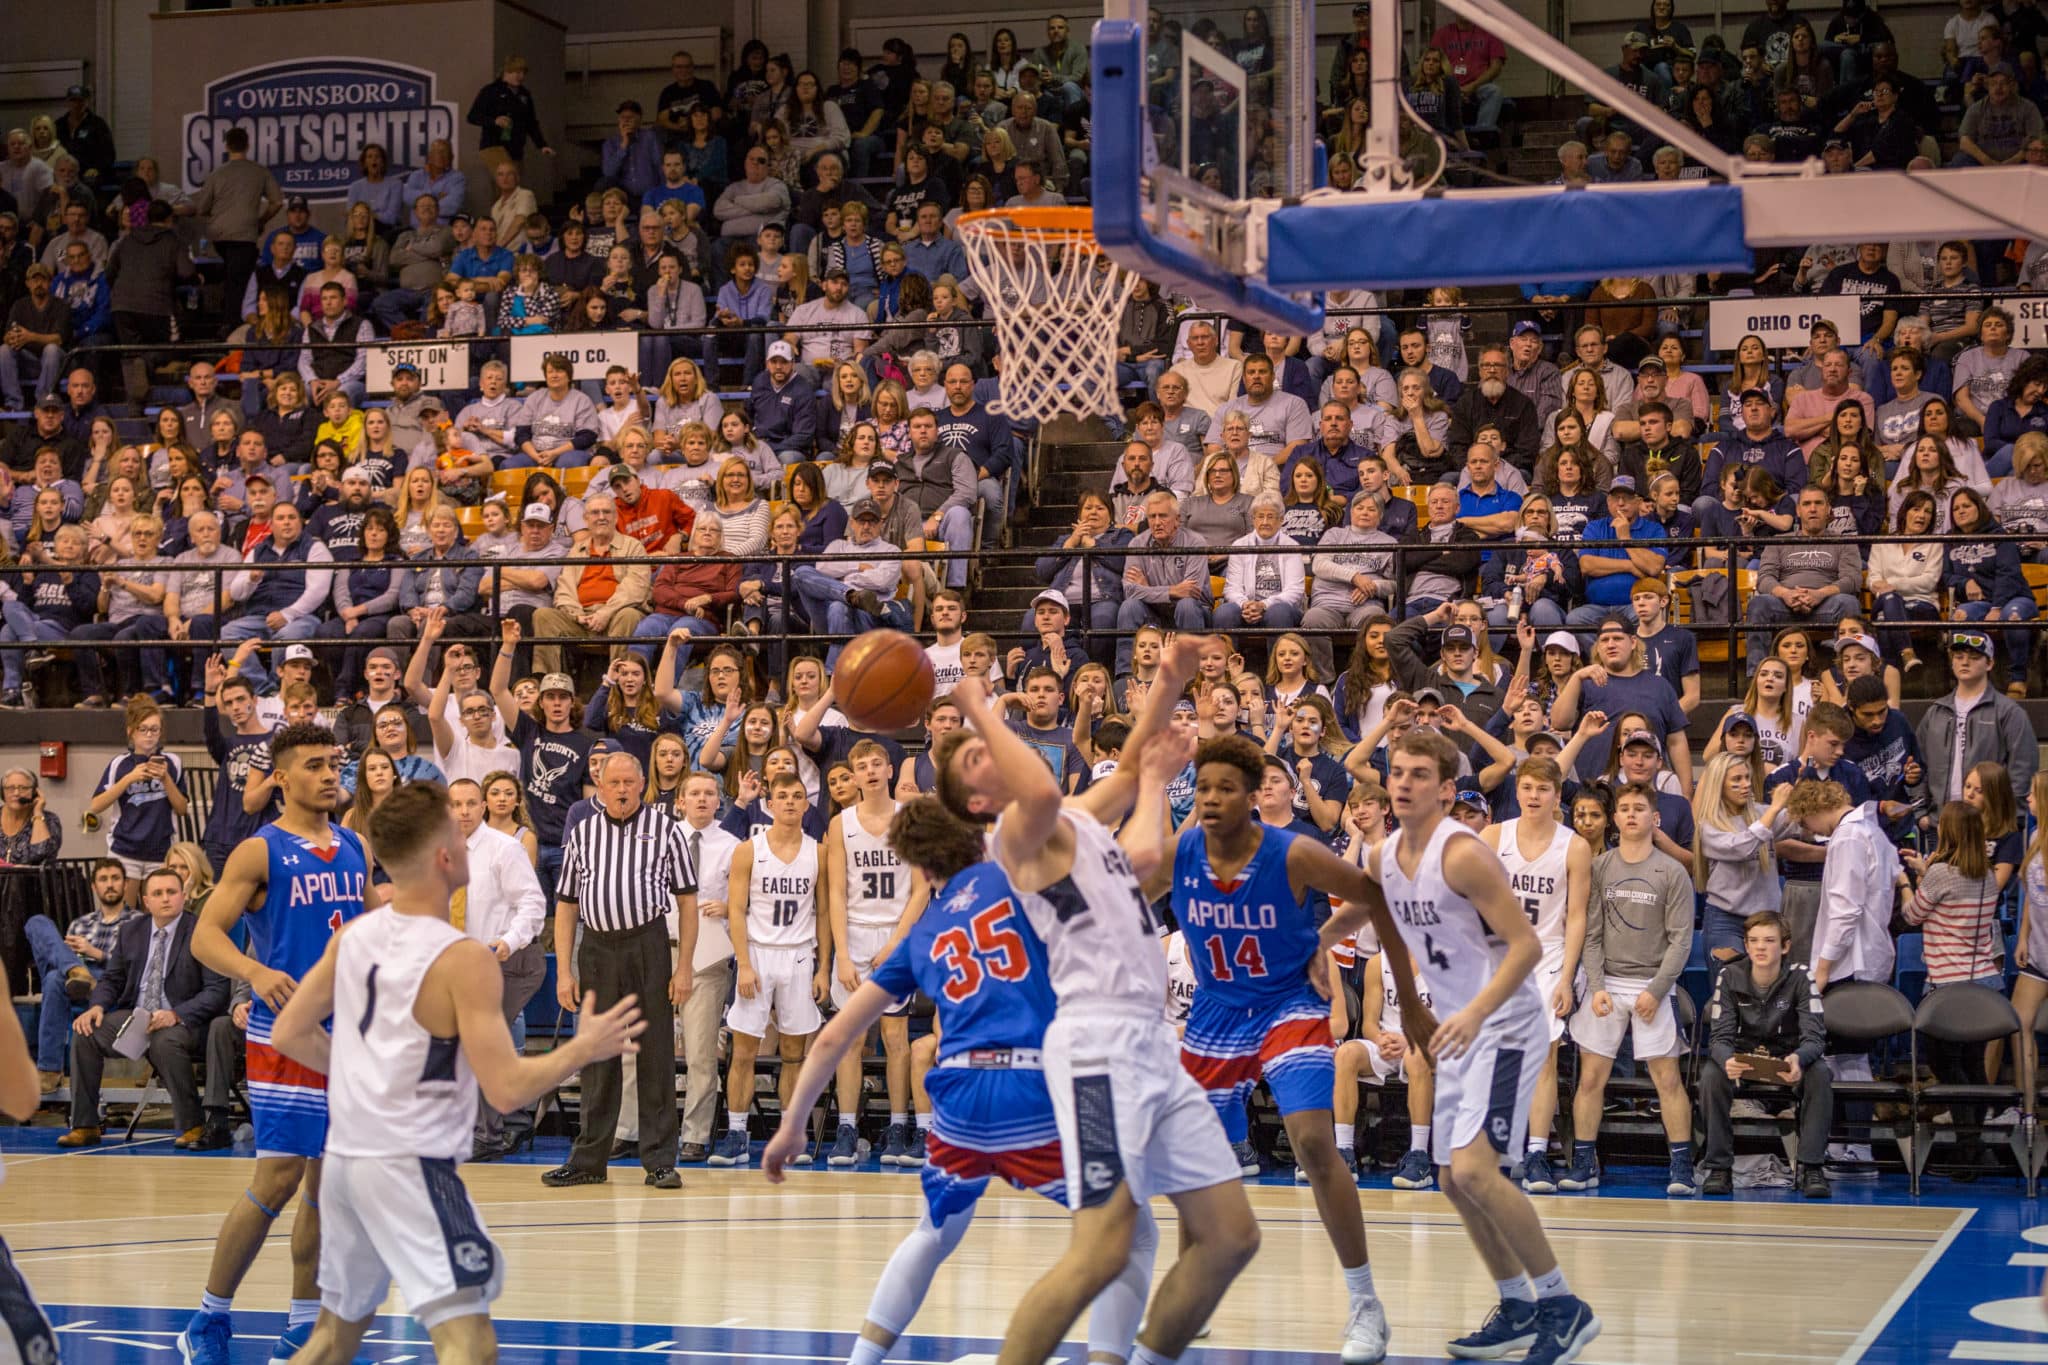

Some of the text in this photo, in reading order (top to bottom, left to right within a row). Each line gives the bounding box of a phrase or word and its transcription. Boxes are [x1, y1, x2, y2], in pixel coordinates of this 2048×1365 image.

[237, 81, 400, 110] OWENSBORO
[286, 167, 350, 182] EST. 1949
[1747, 315, 1791, 331] OHIO
[543, 349, 610, 364] OIO CO.
[952, 422, 978, 435] COUNTY
[328, 537, 360, 549] EAGLE
[934, 664, 965, 677] enior
[545, 742, 580, 763] COUNTY
[289, 871, 364, 907] APOLLO
[762, 877, 810, 895] EAGLES
[863, 872, 895, 899] 30
[1512, 874, 1555, 895] AGLES
[772, 900, 798, 926] 10
[1188, 898, 1277, 930] APOLLO
[1394, 900, 1441, 926] EAGLES
[1517, 896, 1540, 926] 5
[929, 897, 1031, 1004] 35
[1204, 934, 1269, 982] 14
[1425, 932, 1450, 970] 4
[358, 964, 379, 1041] 1
[1387, 989, 1433, 1009] EAES
